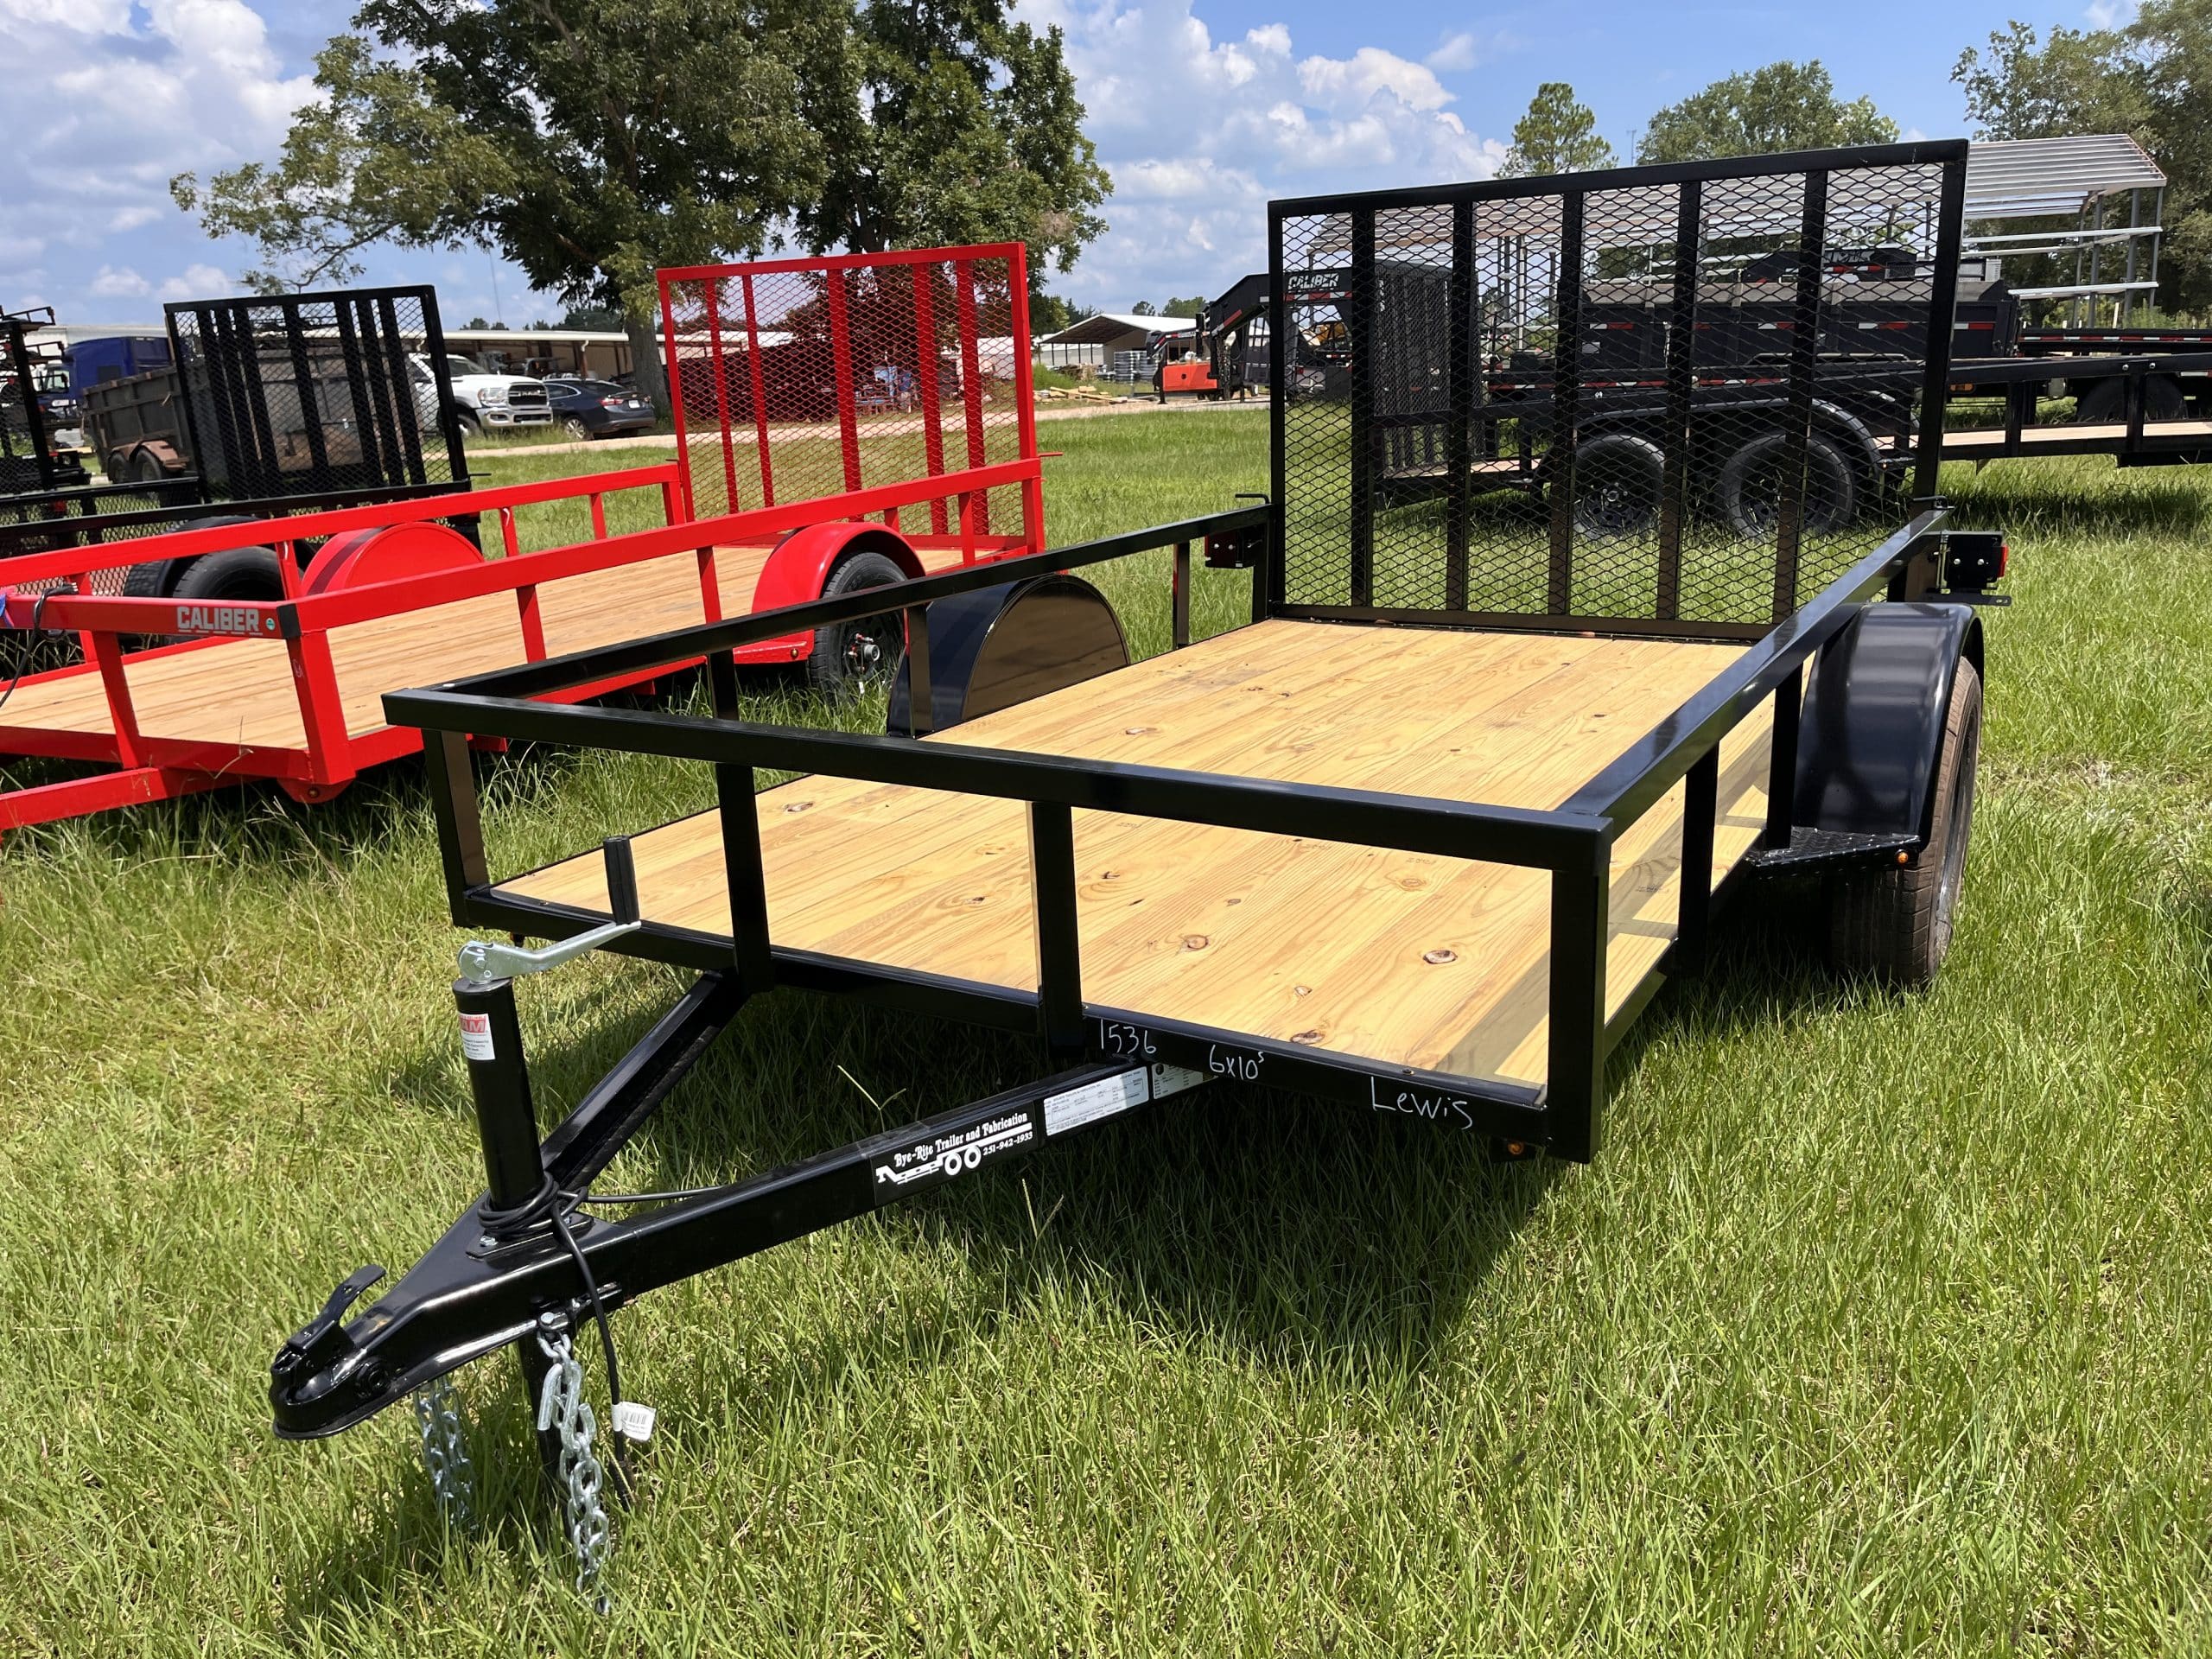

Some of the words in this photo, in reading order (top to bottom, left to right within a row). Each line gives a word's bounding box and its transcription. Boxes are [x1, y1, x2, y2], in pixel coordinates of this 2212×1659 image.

[1287, 273, 1339, 289] CALIBER
[176, 606, 260, 632] CALIBER
[461, 1020, 485, 1032] AM
[1100, 1018, 1157, 1054] 1536
[934, 1132, 964, 1153] Trailer
[965, 1126, 981, 1141] and
[981, 1111, 1028, 1136] Fabrication
[982, 1130, 1033, 1156] 251-942-1933
